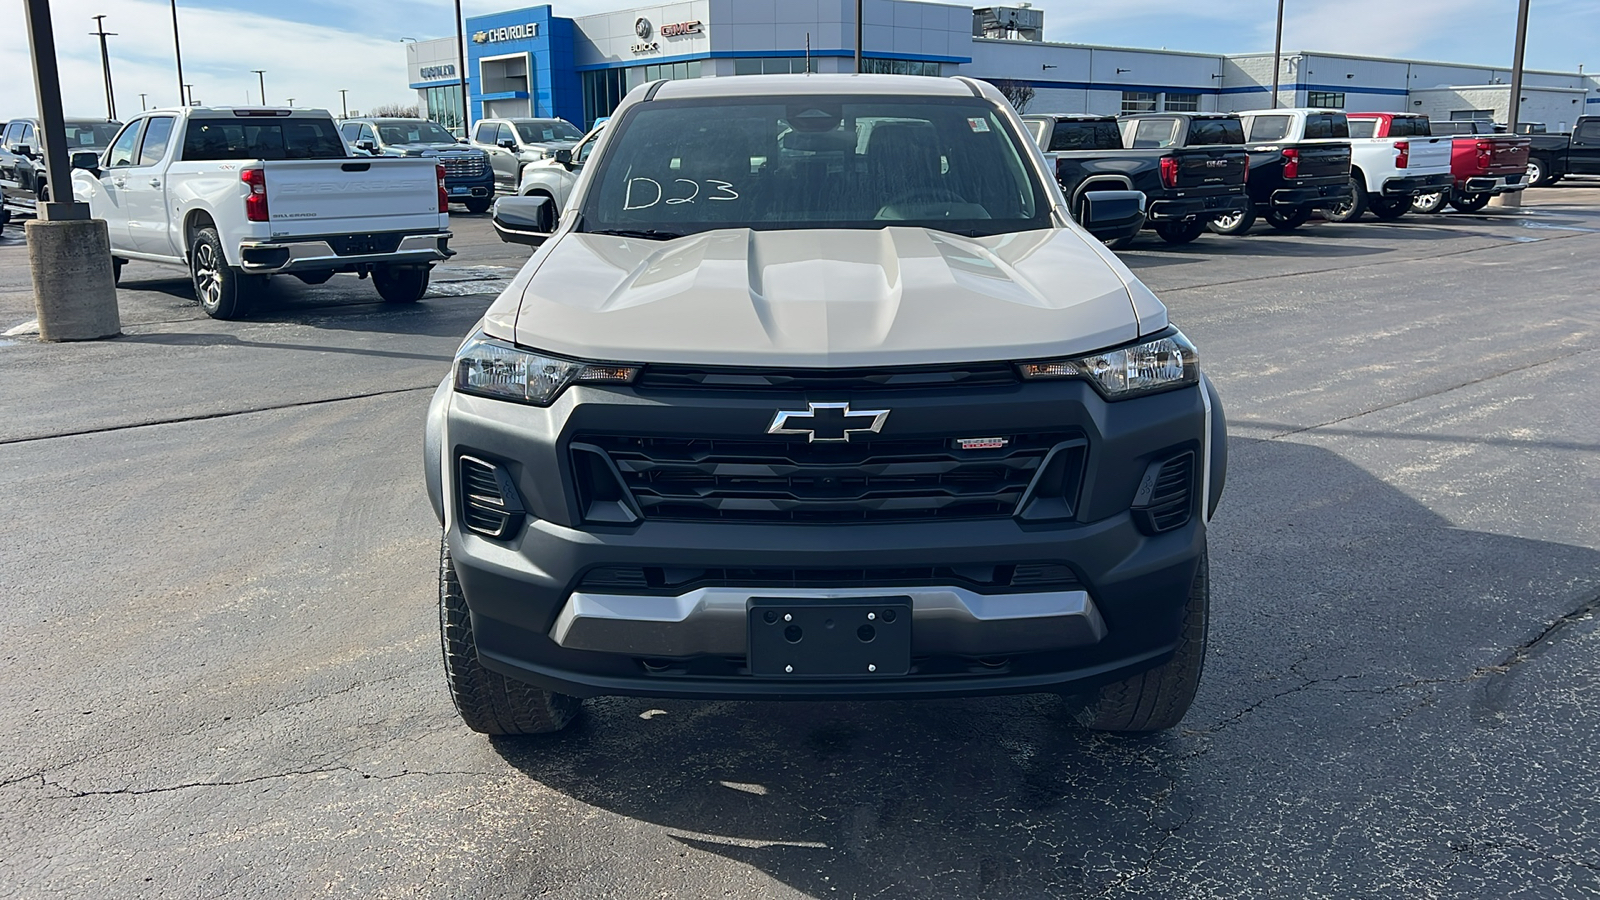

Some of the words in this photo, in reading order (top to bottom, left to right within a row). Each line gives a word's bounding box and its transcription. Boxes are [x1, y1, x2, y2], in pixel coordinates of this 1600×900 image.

[488, 22, 538, 42] CHEVROLET
[661, 21, 701, 37] GMC
[631, 43, 656, 52] BUICK
[281, 180, 429, 194] CHEVROLET
[623, 177, 739, 210] D23
